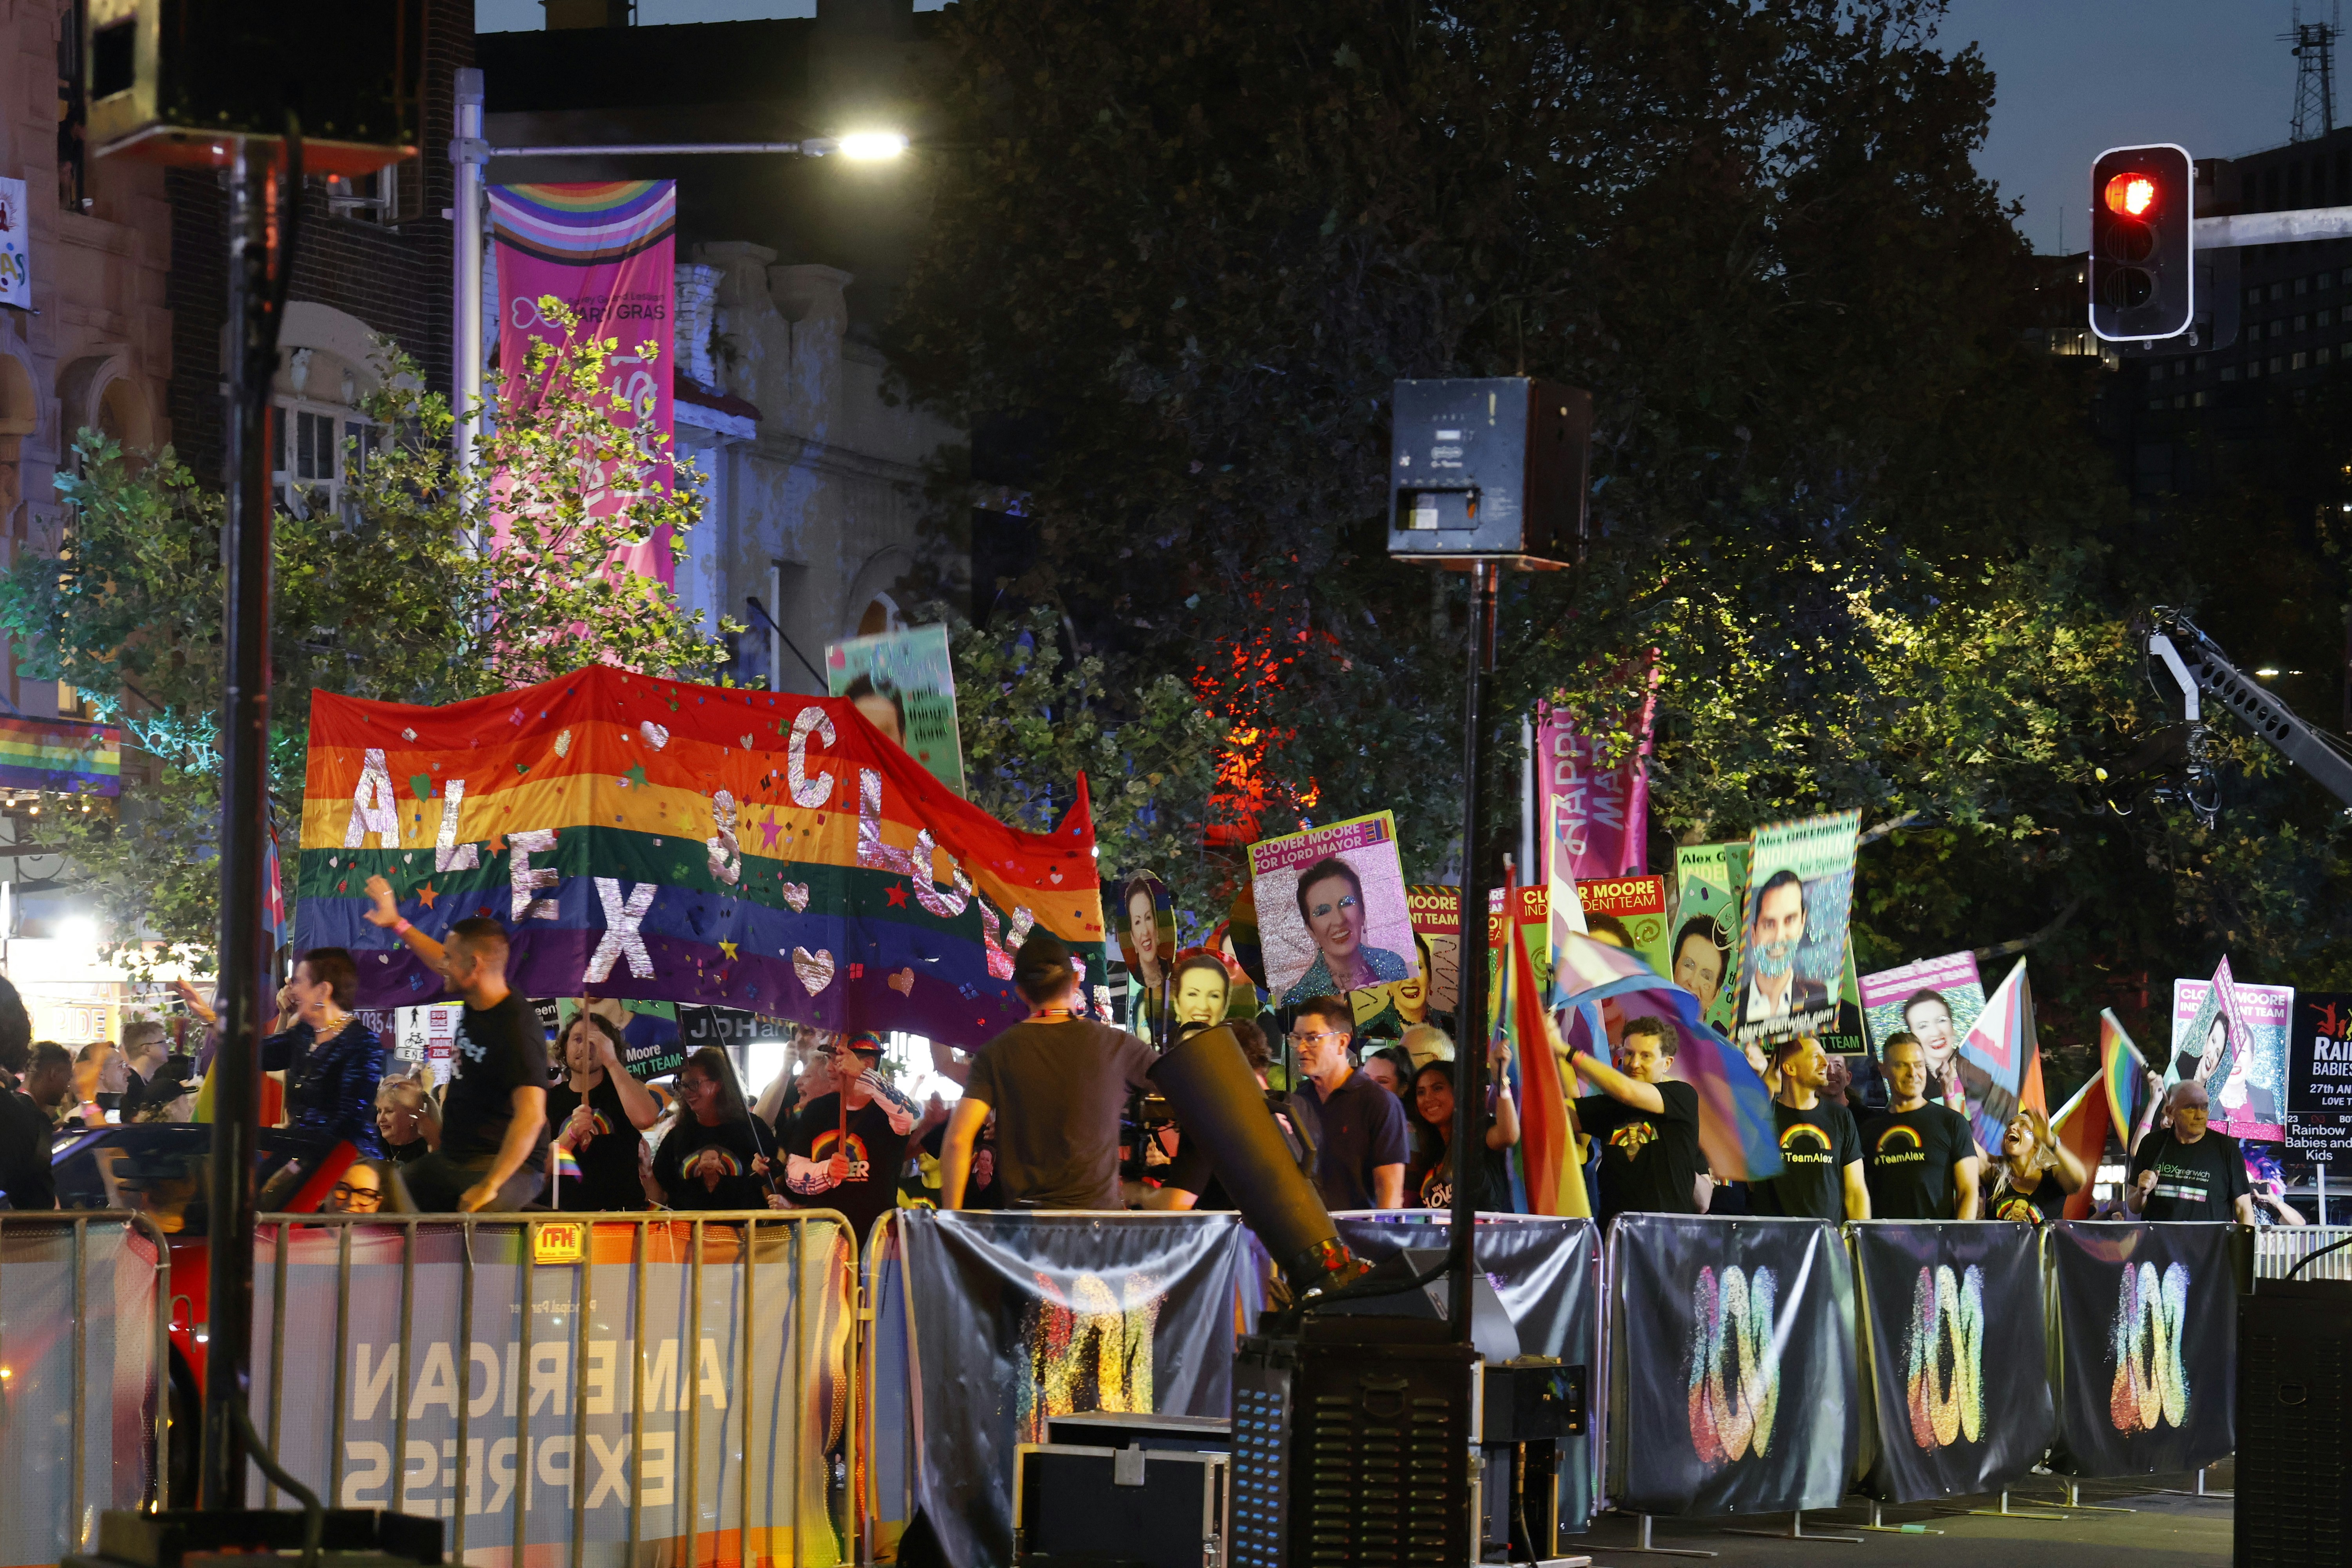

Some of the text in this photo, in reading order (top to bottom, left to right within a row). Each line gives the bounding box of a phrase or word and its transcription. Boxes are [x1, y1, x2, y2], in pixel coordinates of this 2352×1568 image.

[617, 305, 665, 319] GRAS
[1252, 823, 1360, 859] CLOVER MOORE
[1254, 836, 1362, 871] FOR LORD MAYOR
[1681, 853, 1711, 865] Alex
[343, 748, 658, 983] ALEX
[788, 706, 1114, 1026] CLOV
[1523, 886, 1588, 904] CLR
[1593, 880, 1655, 898] MOORE
[1619, 894, 1656, 908] TEAM
[1425, 913, 1459, 925] TEAM
[2236, 991, 2285, 1006] MOORE
[2256, 1007, 2284, 1018] TEAM
[53, 1006, 105, 1040] PIDE
[2234, 1002, 2246, 1045] MOORE
[1829, 1035, 1860, 1050] TEAM
[2232, 1029, 2241, 1054] TEAM
[2314, 1036, 2352, 1061] RAI
[627, 1043, 661, 1062] Moore
[650, 1053, 681, 1072] TEAM
[2310, 1083, 2352, 1094] 27th AN
[2322, 1097, 2345, 1105] LOVE
[2292, 1124, 2346, 1136] Rainbow
[2285, 1137, 2352, 1148] Babies and
[1780, 1152, 1833, 1164] #TeamAlex
[2306, 1149, 2333, 1160] Kids
